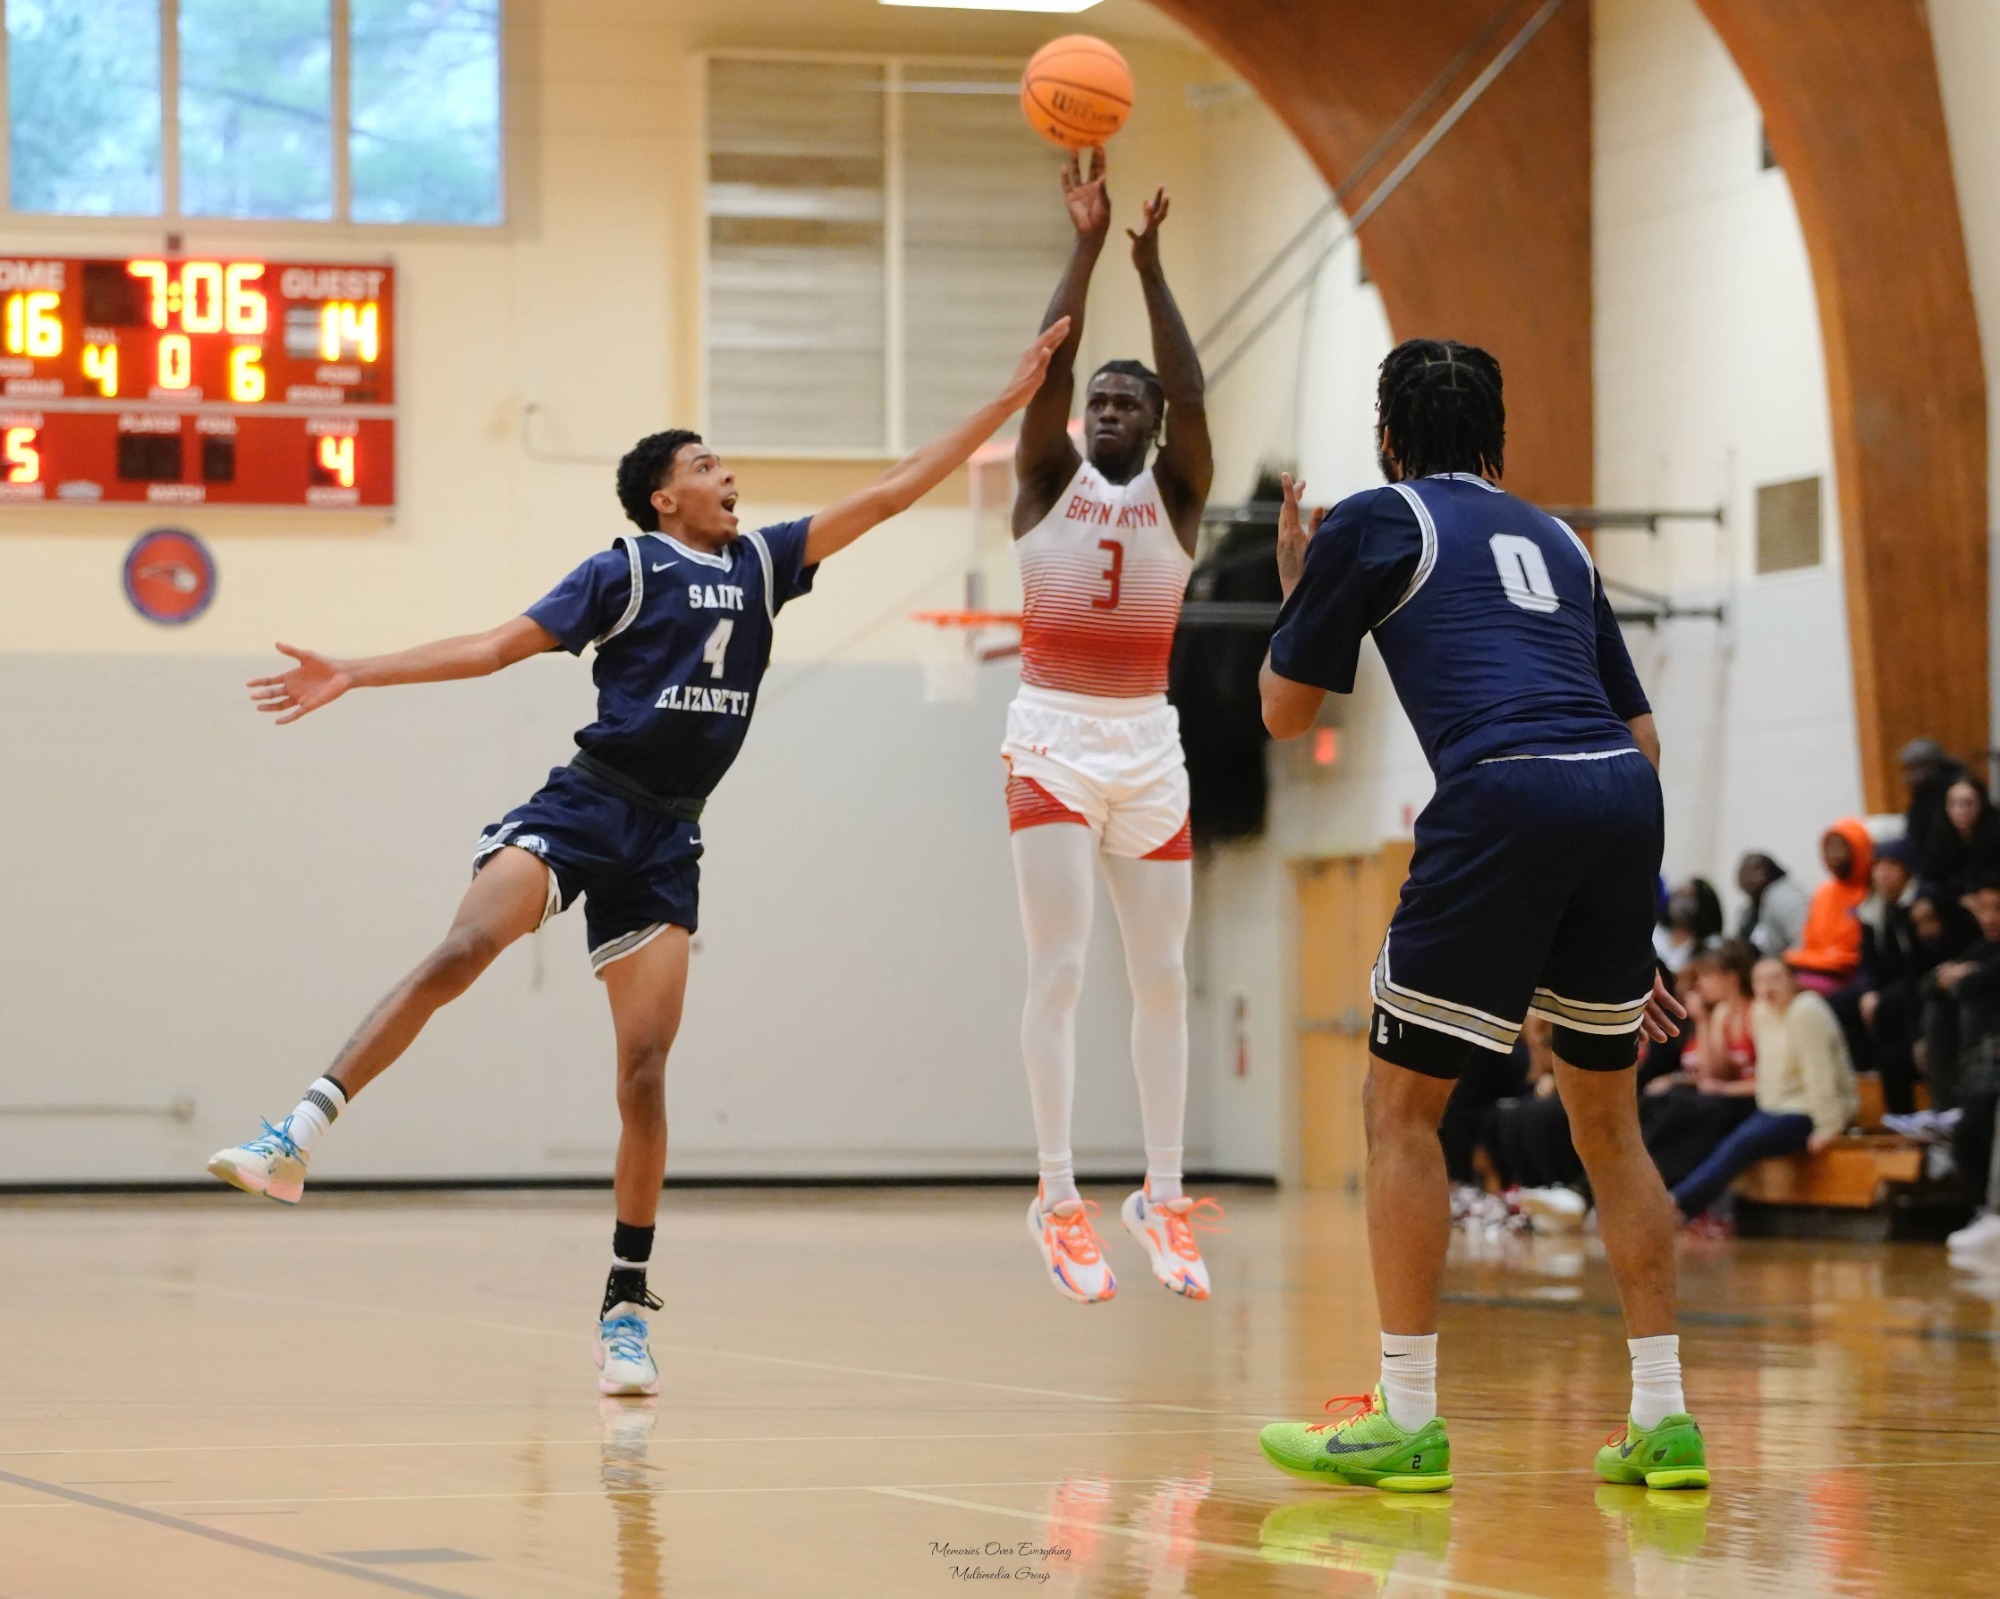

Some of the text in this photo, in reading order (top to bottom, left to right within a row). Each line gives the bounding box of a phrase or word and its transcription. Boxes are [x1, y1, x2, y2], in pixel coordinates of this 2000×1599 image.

[127, 260, 267, 335] 7:06
[281, 267, 385, 299] GUEST
[6, 291, 63, 357] 16
[321, 301, 378, 363] 14
[82, 343, 118, 397] 4
[158, 334, 191, 389] 0
[230, 345, 265, 402] 6
[6, 427, 39, 483] 5
[320, 435, 355, 488] 4
[1065, 495, 1113, 525] BRYN
[688, 583, 744, 611] SAINT
[1090, 538, 1124, 611] 3
[1488, 533, 1560, 614] 0
[702, 618, 734, 679] 4
[1412, 1454, 1421, 1469] 2
